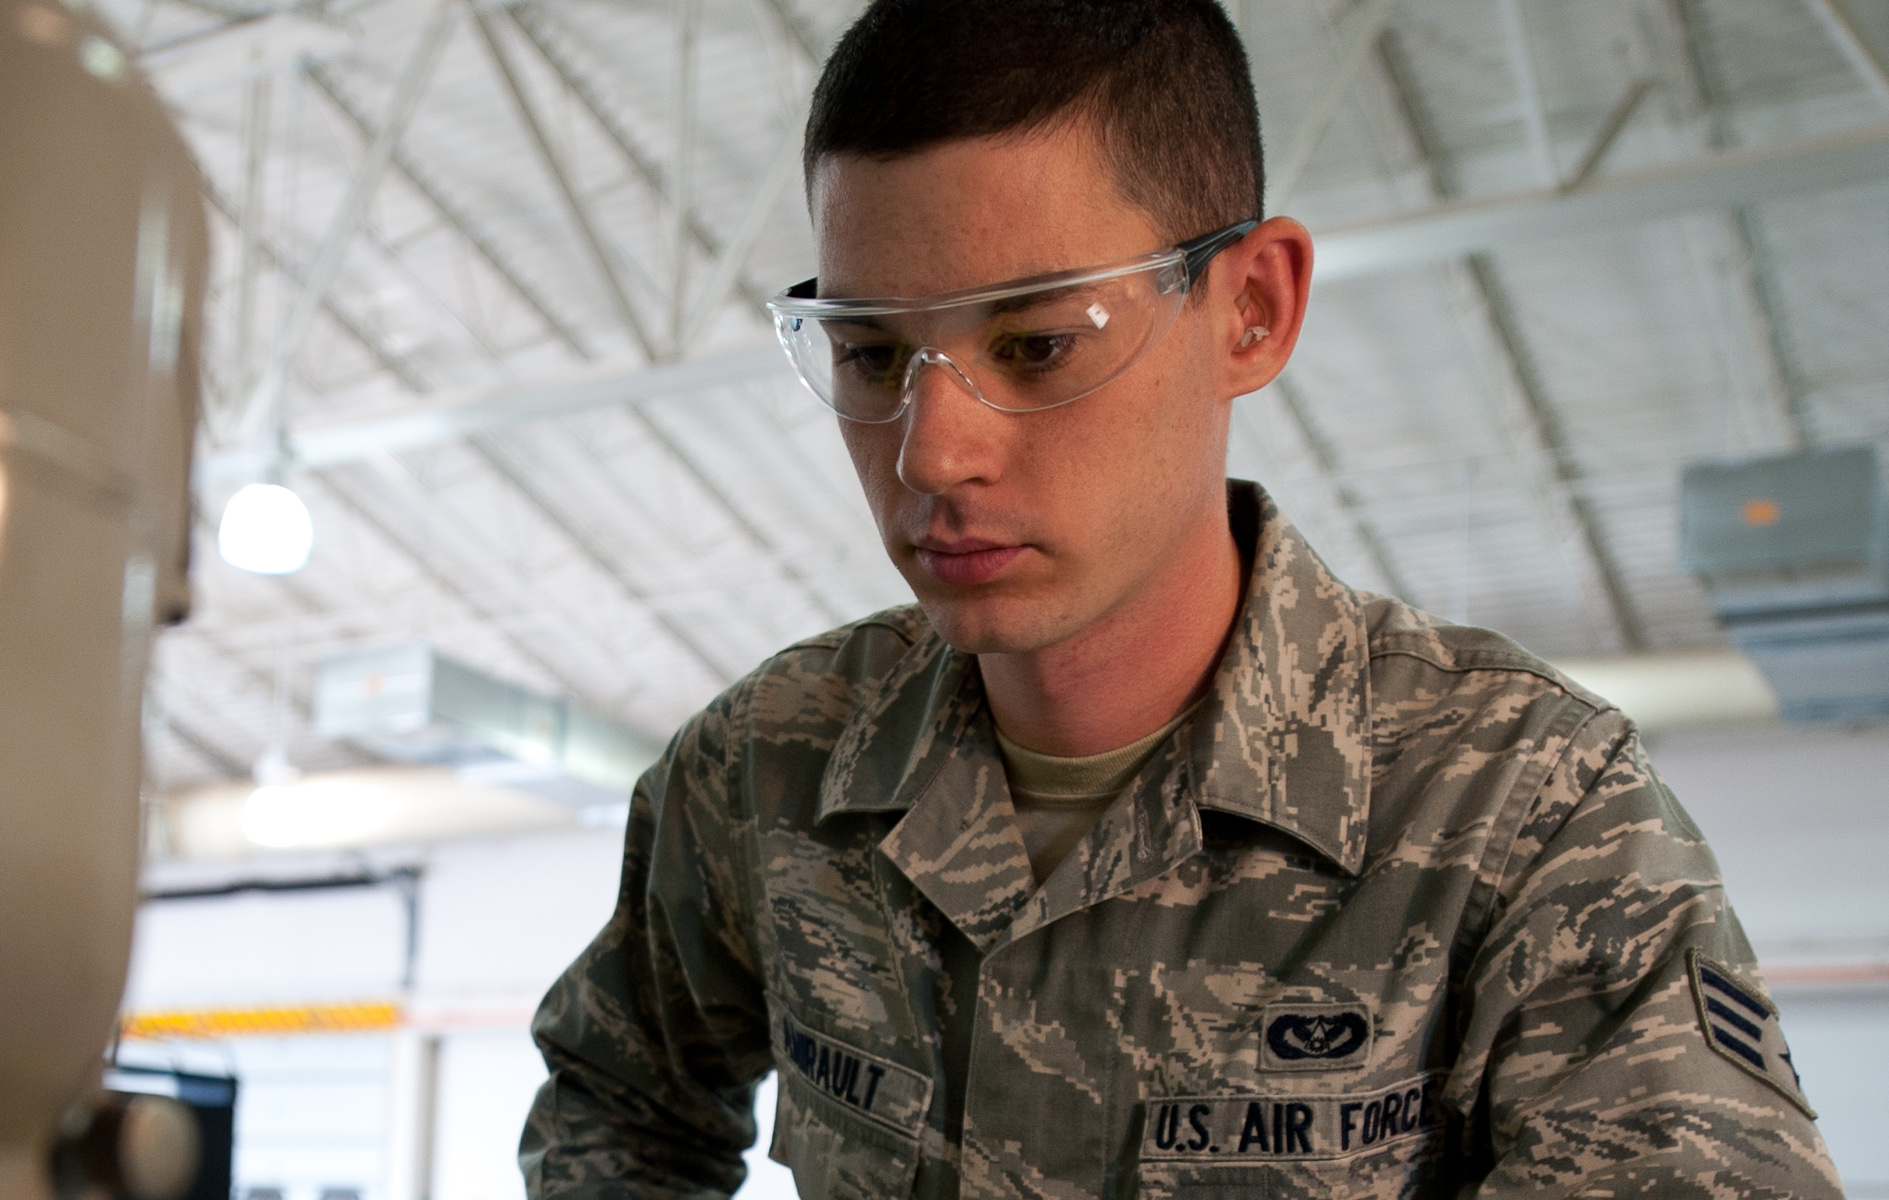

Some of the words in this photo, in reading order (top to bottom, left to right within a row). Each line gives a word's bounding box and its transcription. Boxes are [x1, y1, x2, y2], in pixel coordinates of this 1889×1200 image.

[1155, 1103, 1220, 1153] U.S.
[1238, 1102, 1314, 1154] AIR
[1340, 1079, 1438, 1151] FORCE
